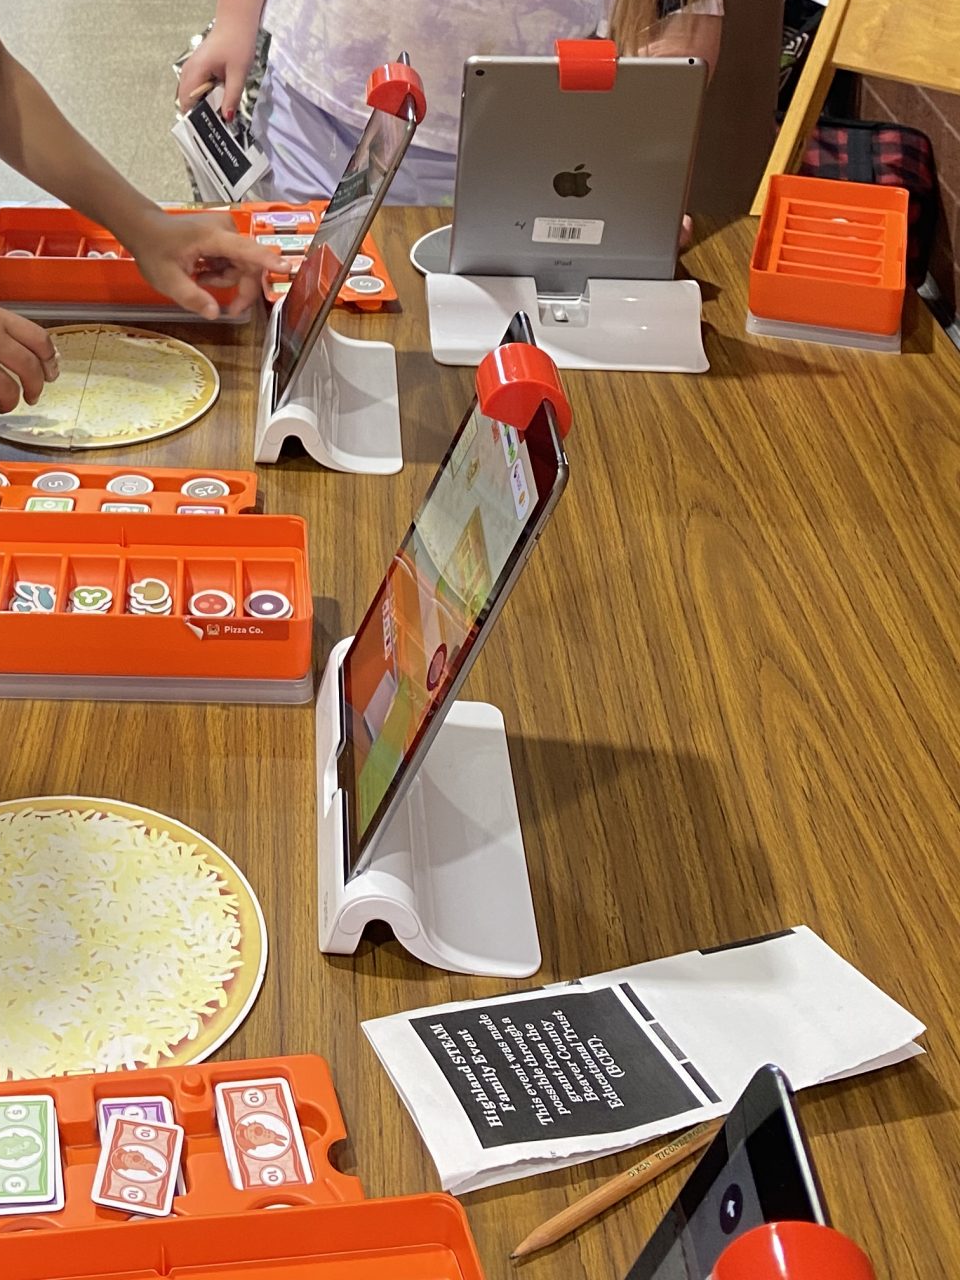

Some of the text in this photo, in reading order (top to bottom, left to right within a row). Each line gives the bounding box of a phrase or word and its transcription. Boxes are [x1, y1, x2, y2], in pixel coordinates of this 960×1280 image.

[220, 140, 240, 168] Family
[47, 480, 64, 488] 5
[121, 481, 139, 493] 10
[194, 484, 218, 497] 25
[224, 625, 264, 634] Pizza Co.
[501, 1016, 572, 1115] possible through a
[525, 1022, 584, 1103] grant from the
[541, 1019, 600, 1102] Beaver County
[552, 1009, 625, 1109] Educational Trust
[587, 1034, 626, 1078] (BCET).
[429, 1023, 504, 1128] Highland STEAM
[457, 1028, 517, 1112] Family Event
[479, 1013, 555, 1126] This event was made
[248, 1091, 260, 1104] 10
[140, 1128, 152, 1139] 10
[267, 1169, 279, 1182] 10
[627, 1160, 652, 1178] DIXON
[127, 1189, 139, 1200] 10
